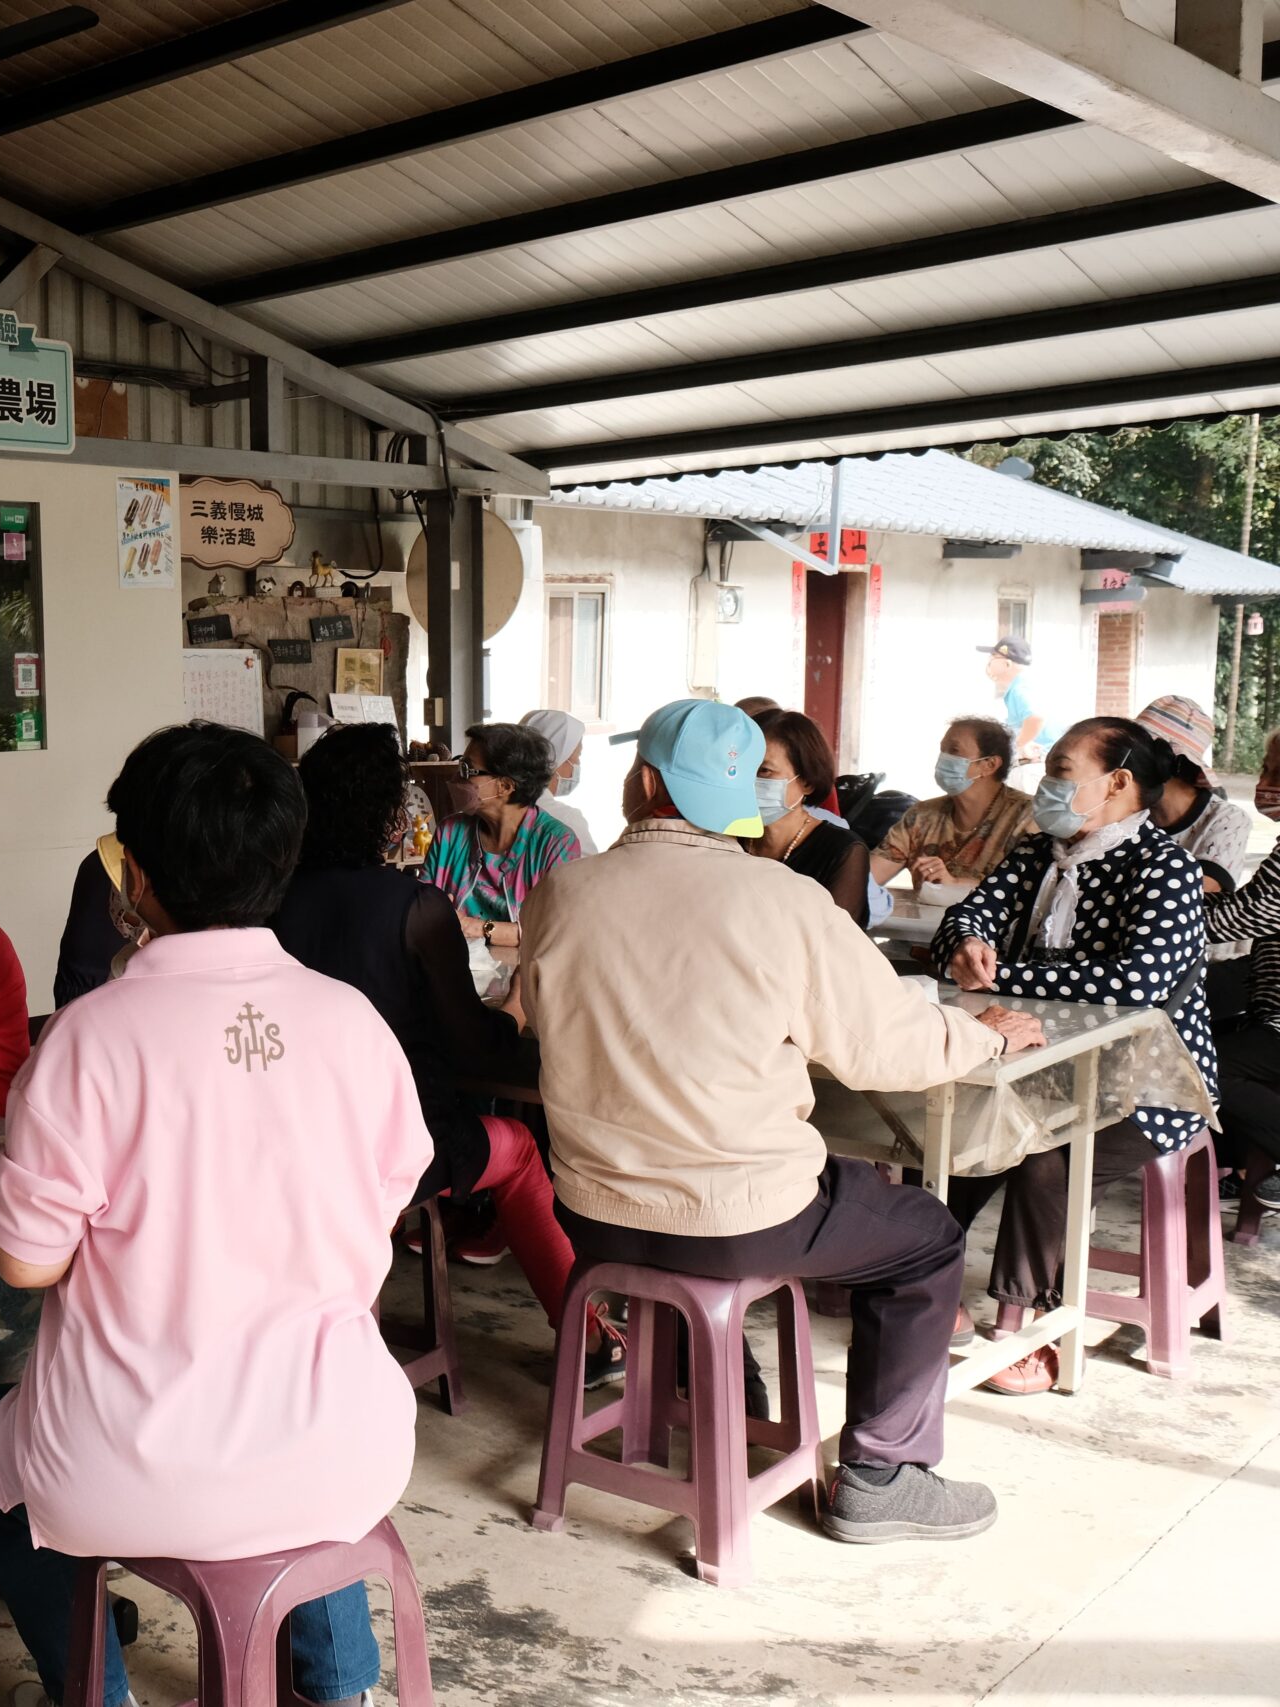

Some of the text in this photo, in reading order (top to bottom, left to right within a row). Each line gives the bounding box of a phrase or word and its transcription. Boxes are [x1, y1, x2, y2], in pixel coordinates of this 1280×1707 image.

[190, 500, 264, 522] 三義慢城
[200, 526, 256, 547] 樂活趣
